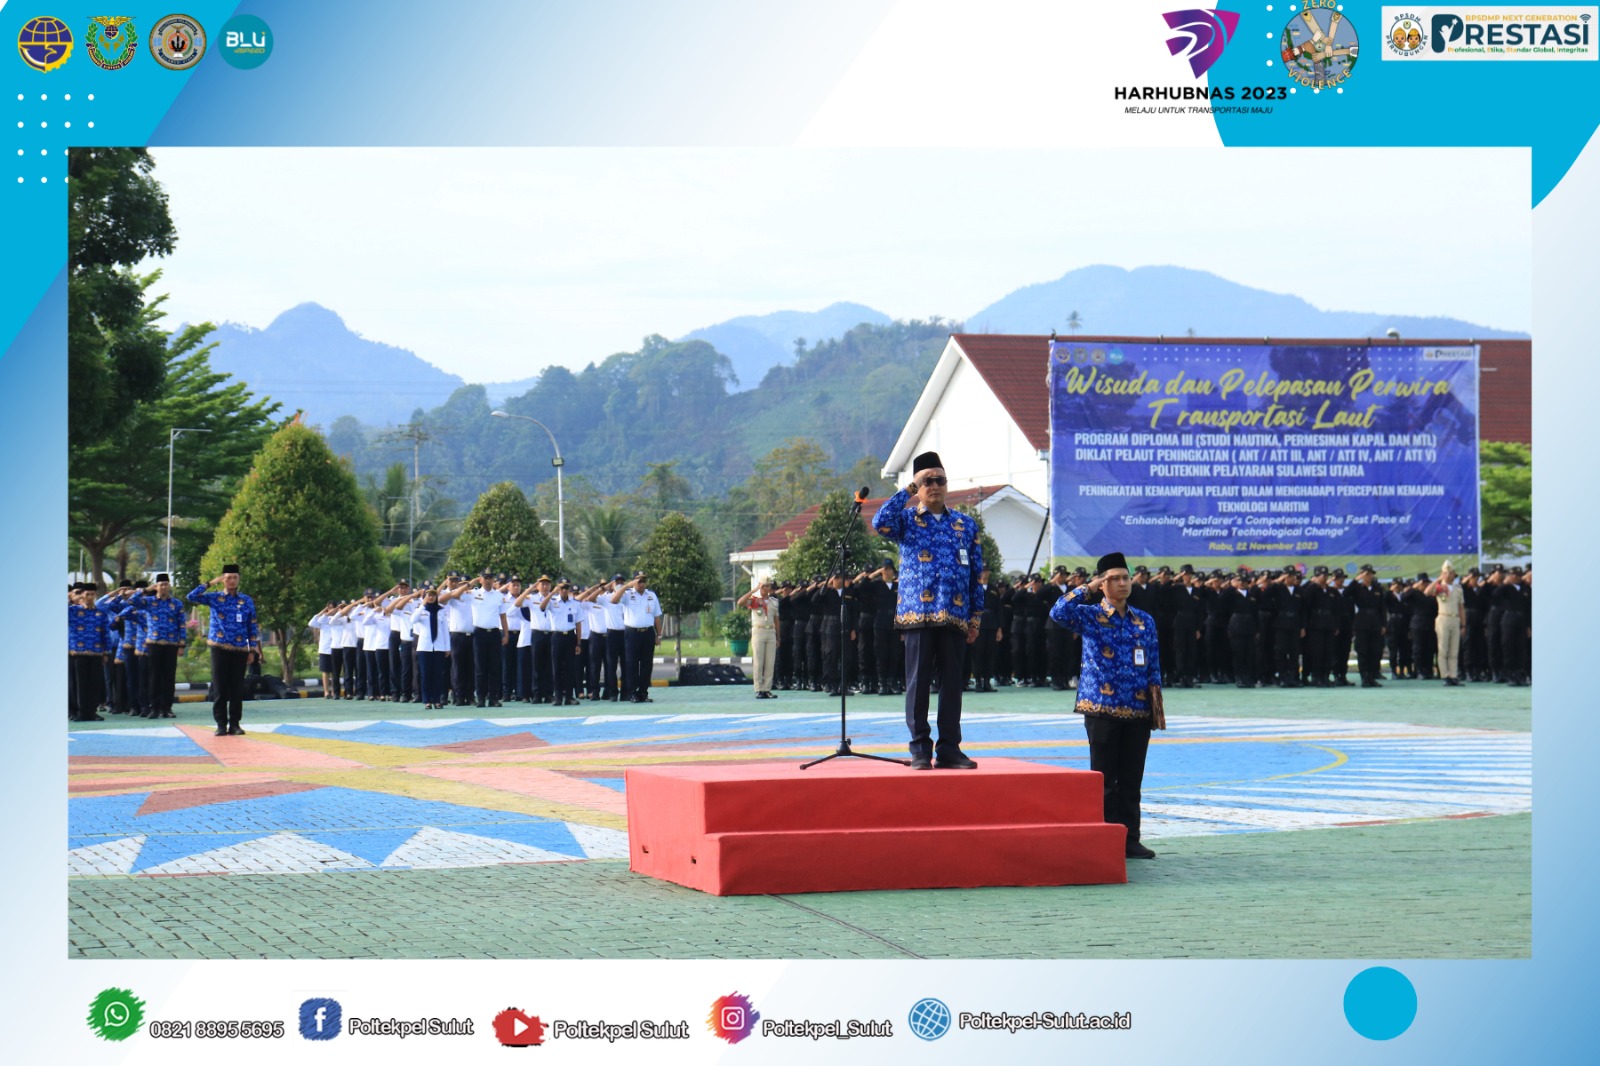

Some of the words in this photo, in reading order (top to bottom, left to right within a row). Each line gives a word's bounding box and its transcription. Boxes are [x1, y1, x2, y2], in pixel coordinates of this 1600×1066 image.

[1065, 366, 1160, 395] Wisuda
[1164, 370, 1213, 395] dan
[1219, 368, 1345, 402] Pelepasan
[1349, 369, 1451, 401] Perwira
[1312, 400, 1384, 430] Laut
[1074, 433, 1128, 446] PROGRAM
[1131, 433, 1179, 446] DIPLOMA
[1182, 433, 1193, 446] III
[1195, 433, 1231, 448] (STUDI
[1233, 433, 1282, 448] NAUTIKA,
[1284, 434, 1350, 446] PERMESINAN
[1352, 434, 1386, 446] KAPAL
[1388, 434, 1410, 446] DAN
[1412, 434, 1437, 448] MTL)
[1075, 449, 1112, 461] DIKLAT
[1115, 449, 1154, 461] PELAUT
[1157, 449, 1229, 462] PENINGKATAN
[1239, 449, 1259, 462] ANT
[1270, 449, 1288, 462] ATT
[1291, 449, 1305, 463] III,
[1307, 449, 1326, 462] ANT
[1337, 449, 1356, 462] ATT
[1358, 449, 1372, 463] IV,
[1374, 449, 1394, 462] ANT
[1404, 449, 1424, 462] ATT
[1425, 449, 1437, 463] V)
[1150, 464, 1210, 477] POLITEKNIK
[1213, 464, 1274, 477] PELAYARAN
[1276, 464, 1328, 477] SULAWESI
[1329, 464, 1364, 477] UTARA
[1079, 485, 1143, 496] PENINGKATAN
[1145, 485, 1204, 496] KEMAMPUAN
[1206, 485, 1239, 496] PELAUT
[1241, 485, 1274, 496] DALAM
[1275, 485, 1335, 496] MENGHADAPI
[1337, 485, 1395, 496] PERCEPATAN
[1397, 485, 1444, 496] KEMAJUAN
[1217, 502, 1268, 512] TEKNOLOGI
[1270, 502, 1309, 512] MARITIM
[1245, 516, 1310, 527] Competence
[1312, 515, 1322, 524] in
[1324, 515, 1343, 524] The
[1346, 515, 1368, 524] Fast
[1370, 515, 1397, 524] Pace
[1399, 515, 1412, 524] of
[1182, 527, 1228, 537] Maritime
[1231, 527, 1302, 539] Technological
[1208, 542, 1234, 552] Rabu,
[1236, 542, 1248, 550] 22
[1250, 542, 1294, 550] November
[1296, 542, 1318, 550] 2023
